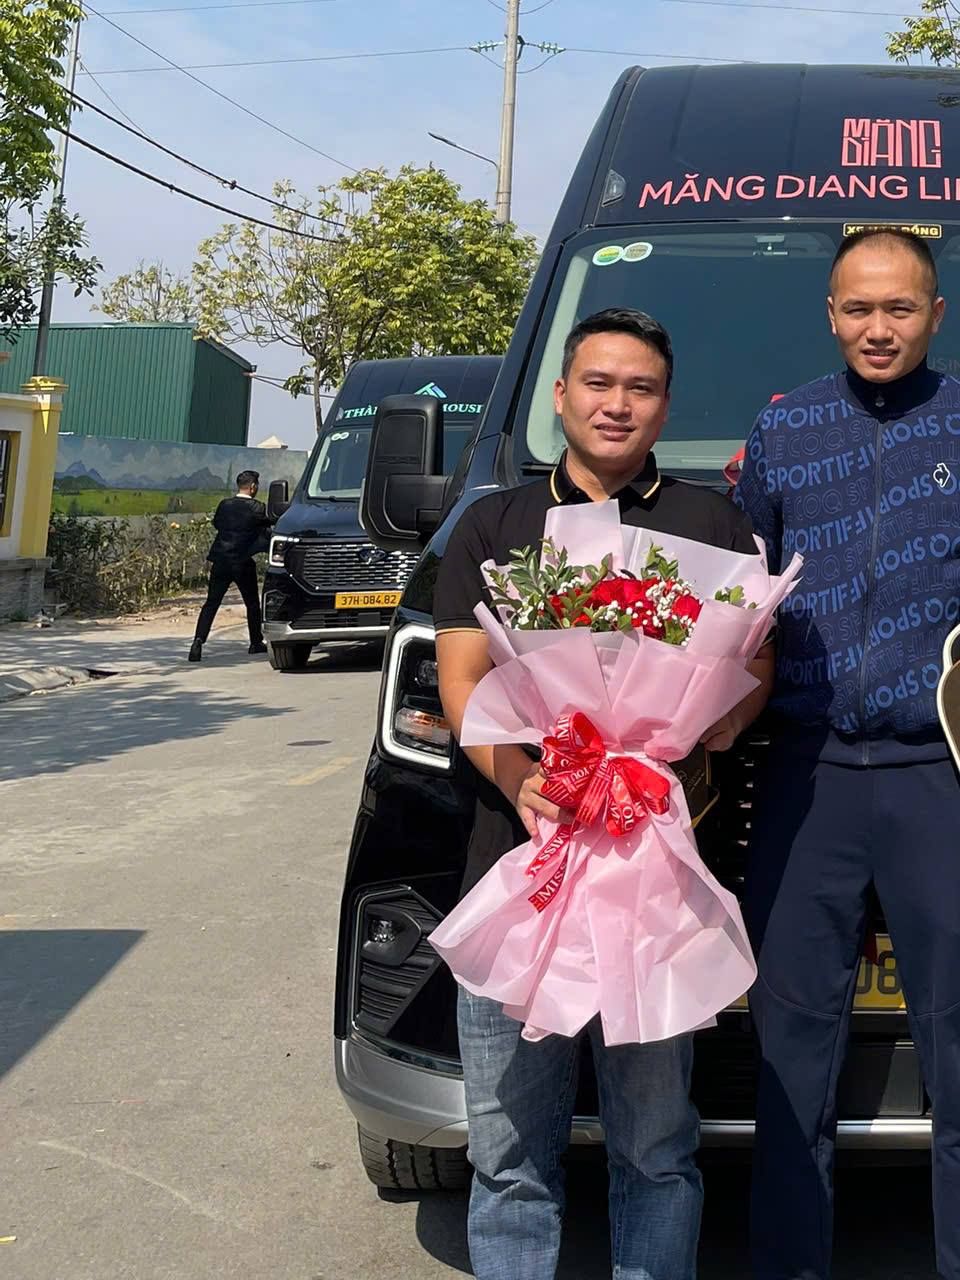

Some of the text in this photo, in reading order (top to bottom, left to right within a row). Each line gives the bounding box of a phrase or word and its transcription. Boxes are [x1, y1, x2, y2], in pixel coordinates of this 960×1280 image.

[639, 173, 766, 208] MĂNG
[775, 175, 908, 200] DIANG
[787, 426, 847, 458] COQ
[765, 451, 856, 495] SPORTIF
[341, 594, 397, 606] 37H-084.82
[783, 582, 849, 620] PORTIF
